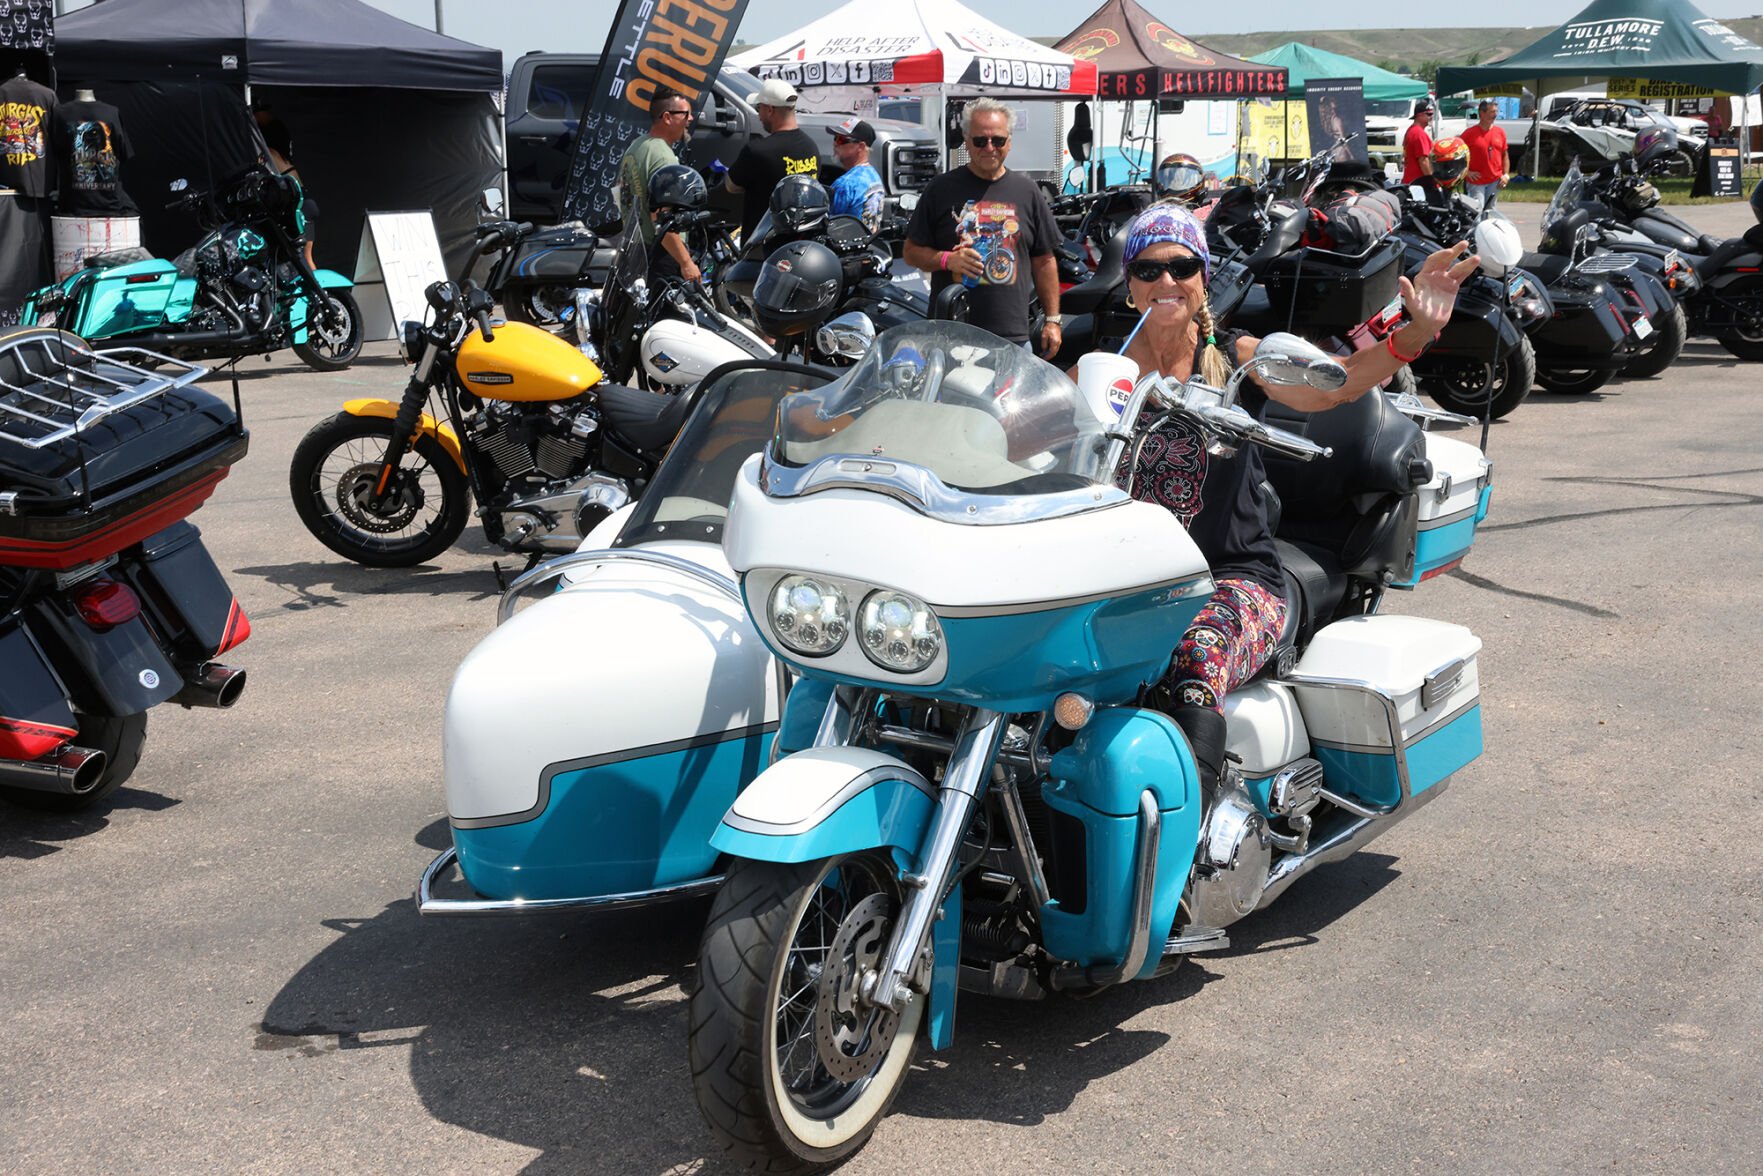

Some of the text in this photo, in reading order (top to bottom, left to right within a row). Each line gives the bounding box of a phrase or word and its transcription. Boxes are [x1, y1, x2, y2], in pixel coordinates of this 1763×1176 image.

[1565, 22, 1661, 40] TULLAMORE
[826, 36, 920, 46] HELP AFTER
[1587, 34, 1625, 49] D.E.W.
[816, 45, 912, 56] DISASTER
[1100, 73, 1147, 95] ERS
[1164, 71, 1285, 94] HELLFIGHTERS
[1608, 84, 1636, 92] SERIES
[1639, 84, 1714, 97] REGISTRATION
